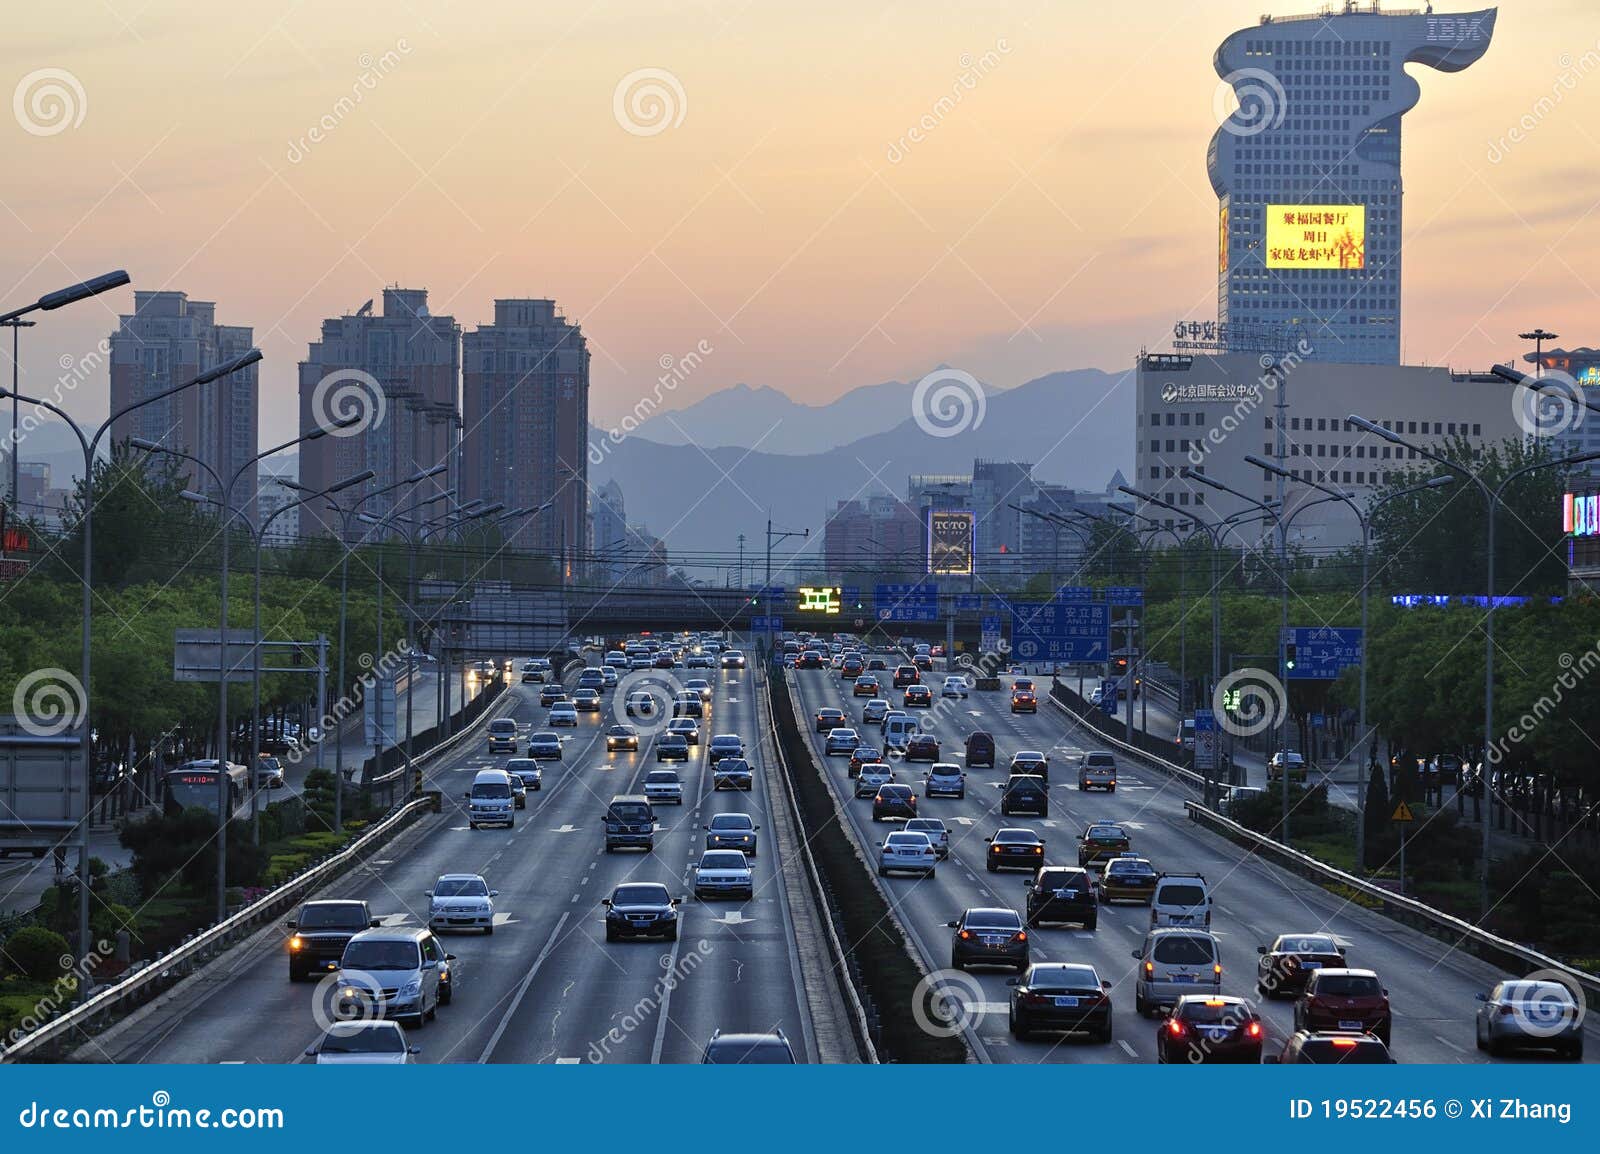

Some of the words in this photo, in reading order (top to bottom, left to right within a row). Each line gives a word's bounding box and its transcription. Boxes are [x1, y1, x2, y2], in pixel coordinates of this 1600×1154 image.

[1426, 18, 1480, 40] IBM
[1283, 212, 1349, 226] 聚福园餐厅
[1303, 231, 1327, 243] 周日
[1178, 384, 1257, 398] 北京国际会议中心
[935, 521, 967, 530] TOTO
[1022, 643, 1034, 656] 51
[1049, 641, 1074, 652] 出口
